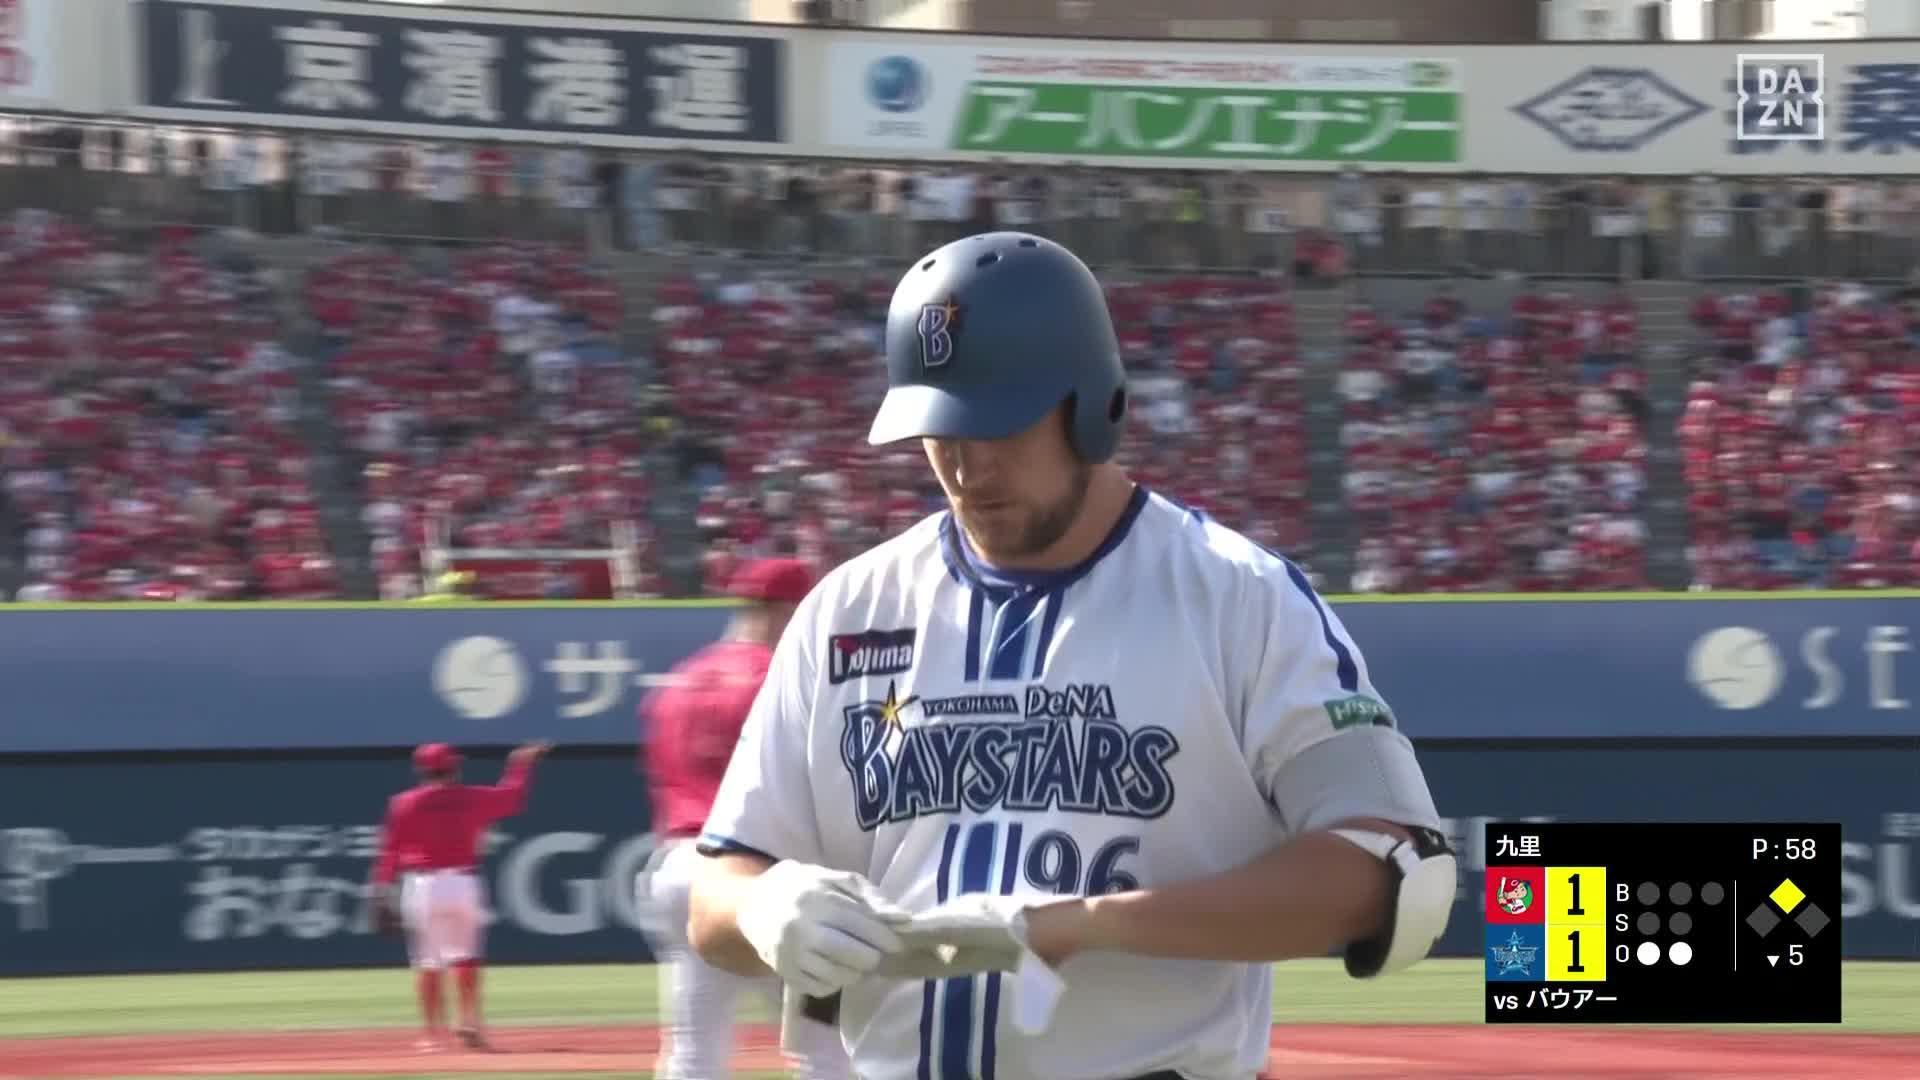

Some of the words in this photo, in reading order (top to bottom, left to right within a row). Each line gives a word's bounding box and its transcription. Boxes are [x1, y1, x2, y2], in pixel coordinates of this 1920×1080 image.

[966, 86, 1457, 154] アーバンエナジー
[922, 695, 1018, 717] YOKOHAMA
[1024, 684, 1117, 719] DeNA
[841, 700, 1180, 832] BAYSTARS
